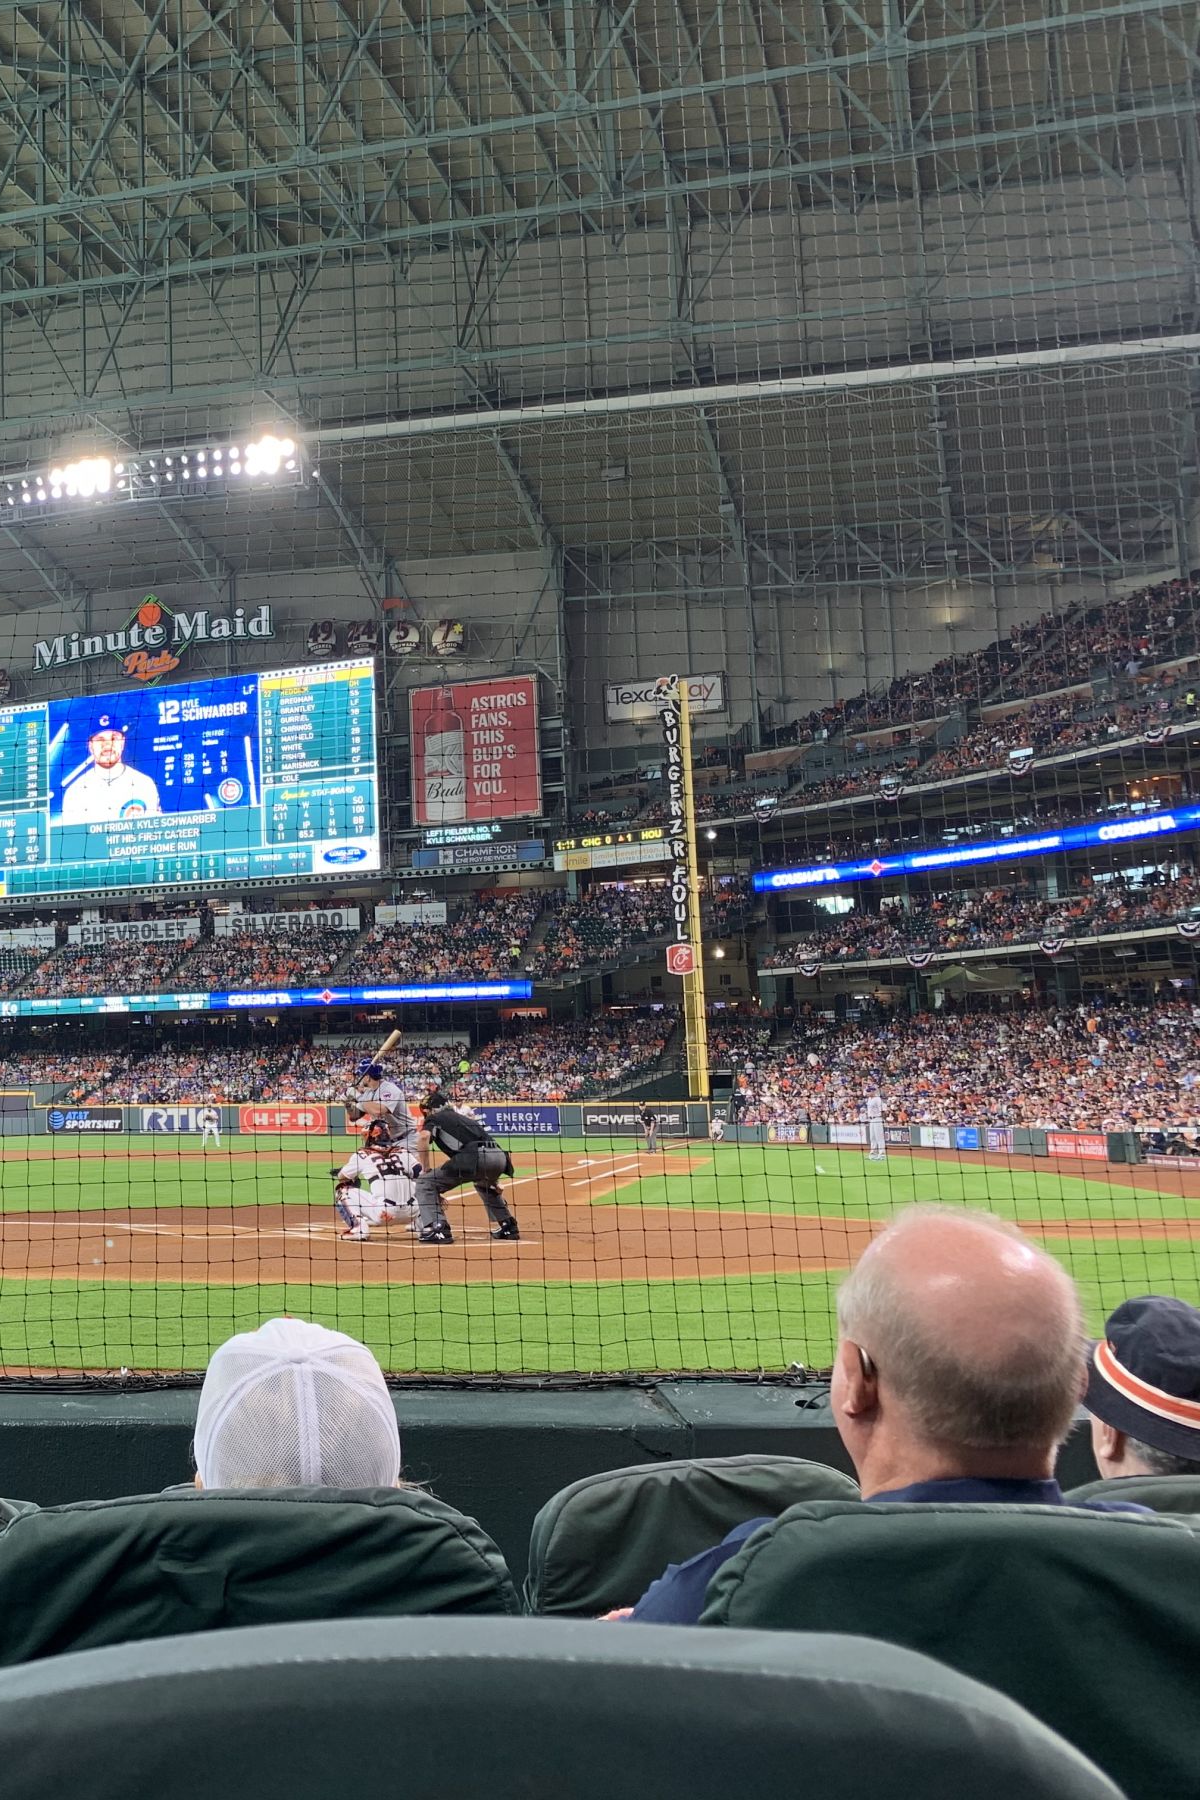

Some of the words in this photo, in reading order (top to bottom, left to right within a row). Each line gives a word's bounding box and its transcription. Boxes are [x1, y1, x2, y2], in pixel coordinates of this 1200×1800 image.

[33, 622, 166, 671] Minute
[172, 605, 273, 642] Maid
[309, 621, 333, 643] 49
[397, 621, 409, 641] 5
[440, 619, 453, 642] 7
[123, 650, 180, 680] Park
[243, 685, 255, 695] LF
[280, 695, 313, 705] BREGMAN
[471, 692, 526, 711] ASTROS
[159, 700, 180, 725] 12
[182, 698, 199, 709] KYLE
[182, 701, 247, 722] SCHWARBER
[280, 704, 315, 715] BRANTLEY
[471, 711, 511, 728] FANS,
[281, 723, 312, 733] CHIRINOS
[471, 729, 504, 745] THIS
[281, 744, 303, 752] WHITE
[472, 744, 516, 762] BUD'S
[282, 752, 306, 761] FISHER
[282, 760, 319, 770] MARISNICK
[473, 763, 501, 778] FOR
[282, 774, 299, 782] COLE
[664, 711, 683, 835] BURGERZ
[311, 786, 355, 796] STAT-BOARD
[473, 780, 507, 796] YOU.
[302, 801, 309, 809] W
[353, 796, 363, 804] SO
[273, 812, 287, 820] 4.11
[352, 805, 365, 813] 100
[353, 816, 364, 824] BB
[90, 825, 101, 833] ON
[137, 819, 159, 830] KYLE
[161, 813, 217, 827] SCHWARBER
[1099, 816, 1176, 840] COUSHATTA
[106, 835, 120, 845] HIT
[122, 834, 136, 843] HIS
[138, 832, 162, 842] FIRST
[164, 828, 200, 840] CAREER
[328, 828, 337, 836] 54
[426, 829, 443, 837] LEFT
[582, 838, 601, 847] CHC
[641, 829, 662, 839] HOU
[110, 847, 148, 857] LEADOFF
[150, 844, 175, 853] HOME
[178, 841, 197, 850] RUN
[455, 844, 517, 857] CHAMPION
[673, 841, 685, 858] R
[226, 856, 248, 864] BALLS
[255, 853, 282, 862] STRIKES
[484, 854, 517, 862] SERVICES
[772, 869, 839, 888] COUSHATTA
[672, 866, 688, 941] FOUL
[231, 912, 343, 934] SILVERADO
[82, 921, 188, 944] CHEVROLET
[66, 1111, 90, 1120] AT&T
[496, 1112, 541, 1122] ENERGY
[66, 1119, 121, 1130] SPORTSNET
[497, 1122, 554, 1132] TRANSFER
